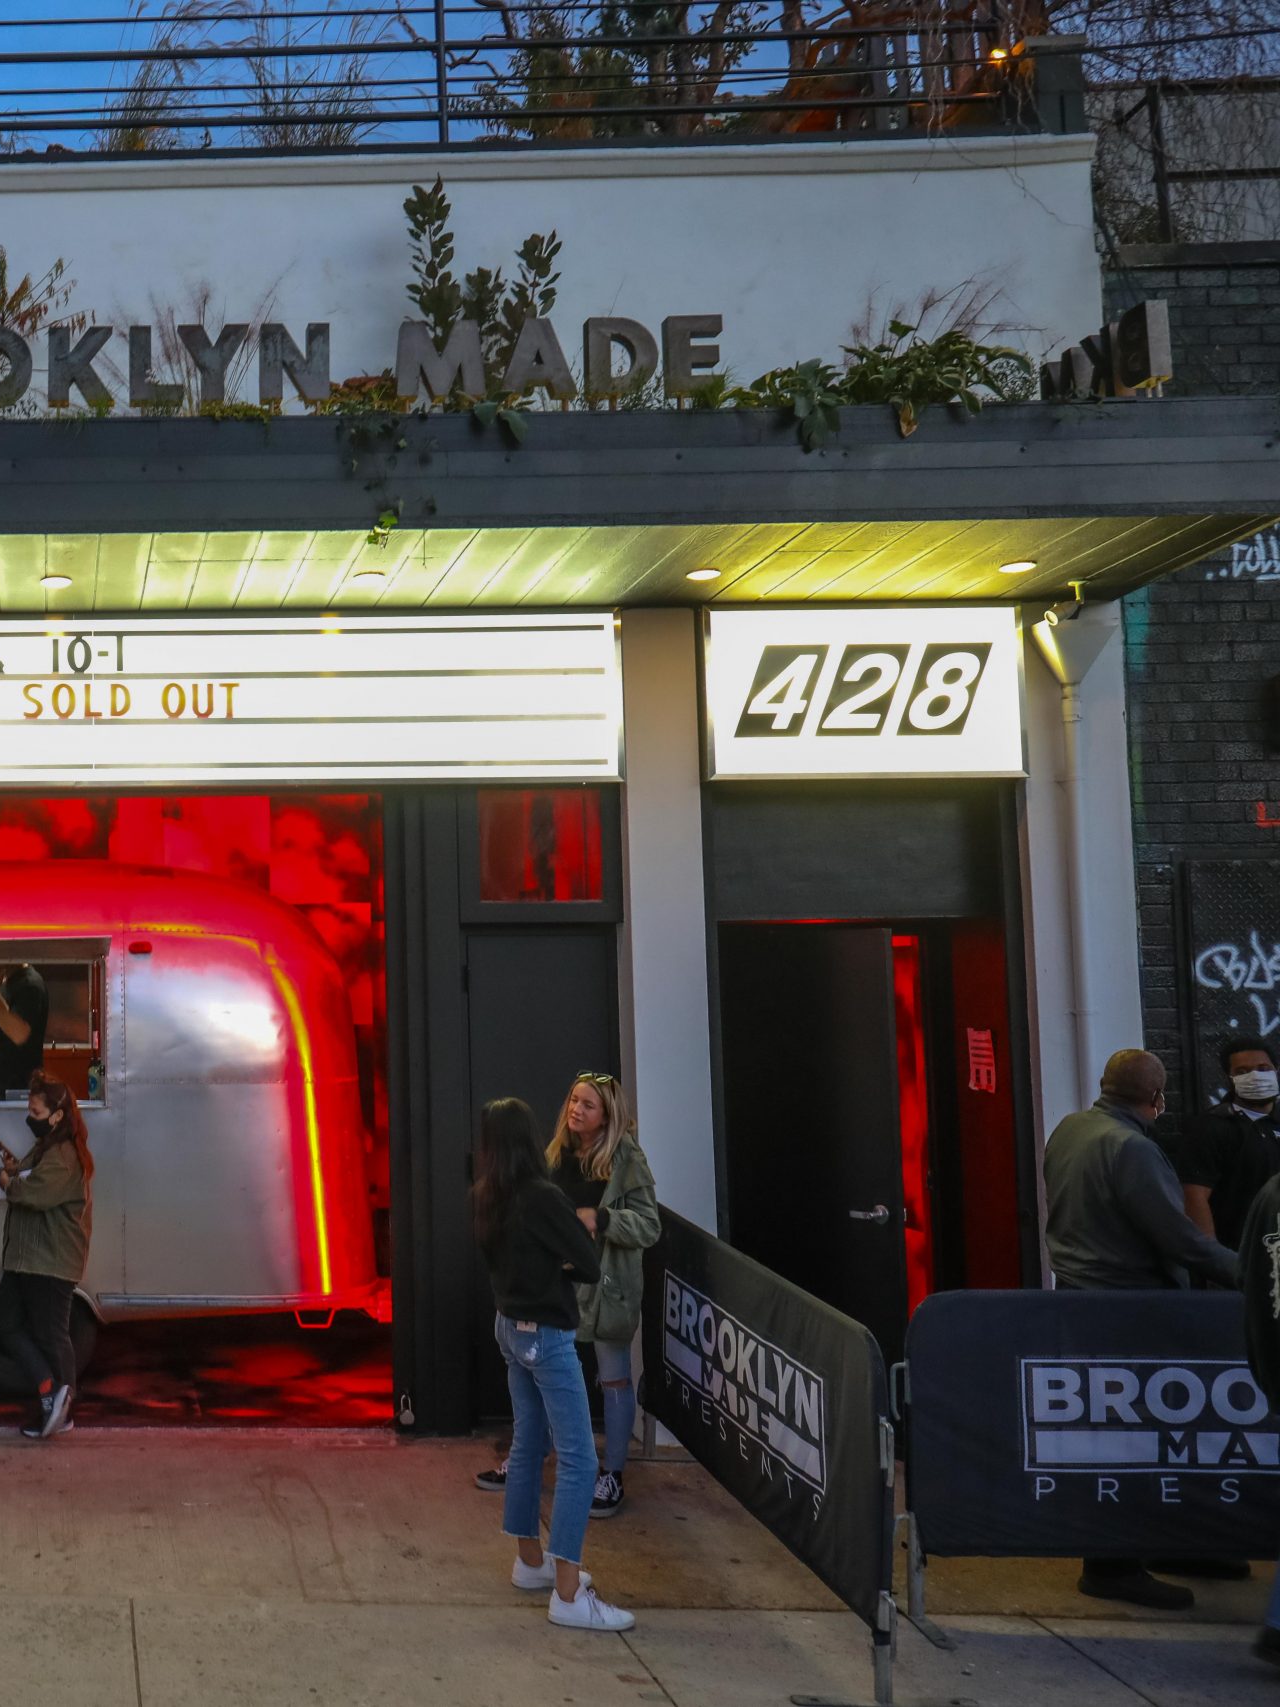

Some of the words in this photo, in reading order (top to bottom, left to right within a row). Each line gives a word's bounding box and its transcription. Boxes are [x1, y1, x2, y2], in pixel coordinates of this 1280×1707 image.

[395, 314, 723, 398] MADE
[51, 635, 125, 673] 10-1
[742, 648, 987, 733] 428
[22, 683, 131, 719] SOLD
[161, 682, 240, 719] OUT
[665, 1279, 820, 1441] BROOKLYN
[701, 1358, 771, 1438] MADE
[666, 1369, 822, 1522] PRESENTS
[1035, 1476, 1241, 1503] PRES
